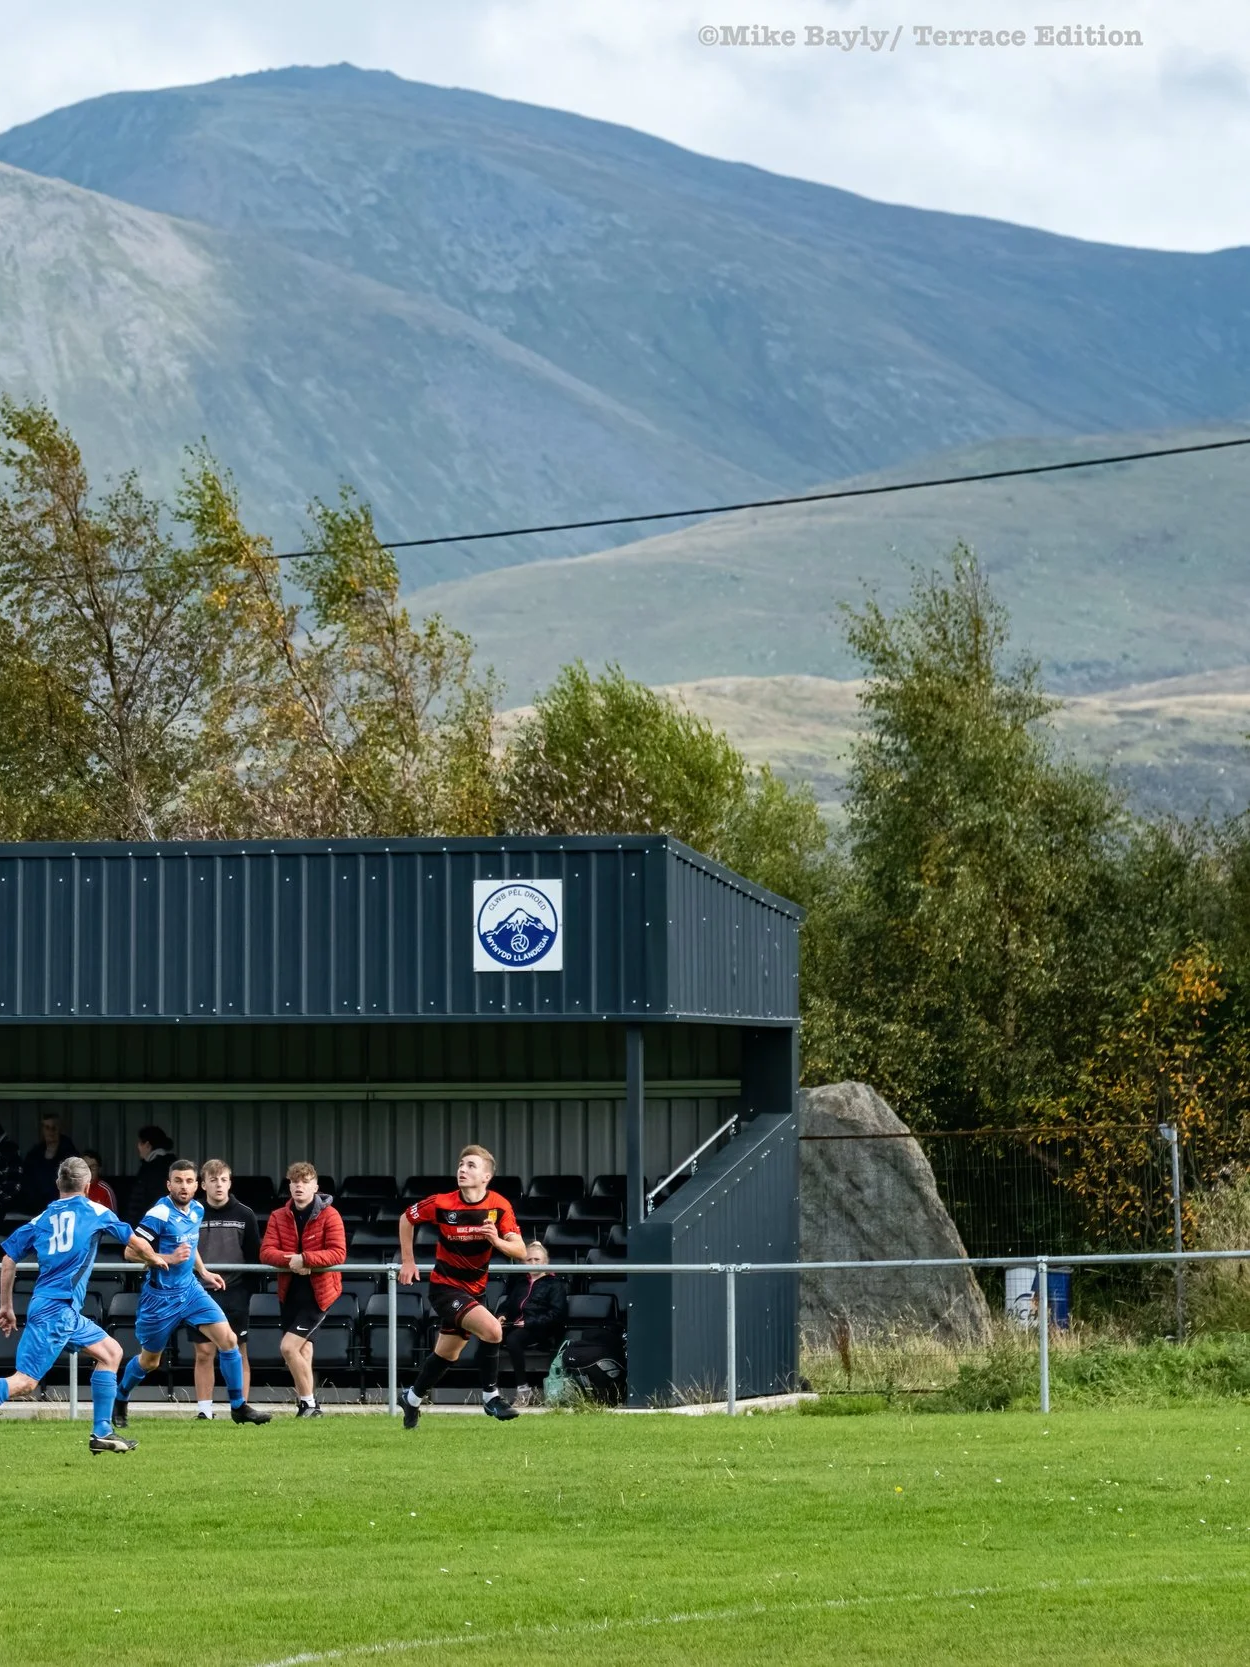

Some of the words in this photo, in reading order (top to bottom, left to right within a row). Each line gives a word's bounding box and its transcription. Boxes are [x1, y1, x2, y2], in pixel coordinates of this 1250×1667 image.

[487, 893, 506, 912] CLWB
[524, 890, 547, 911] DROED
[485, 935, 512, 961] MYNYDD
[513, 935, 550, 962] LLANDEGAI
[47, 1210, 76, 1256] 10
